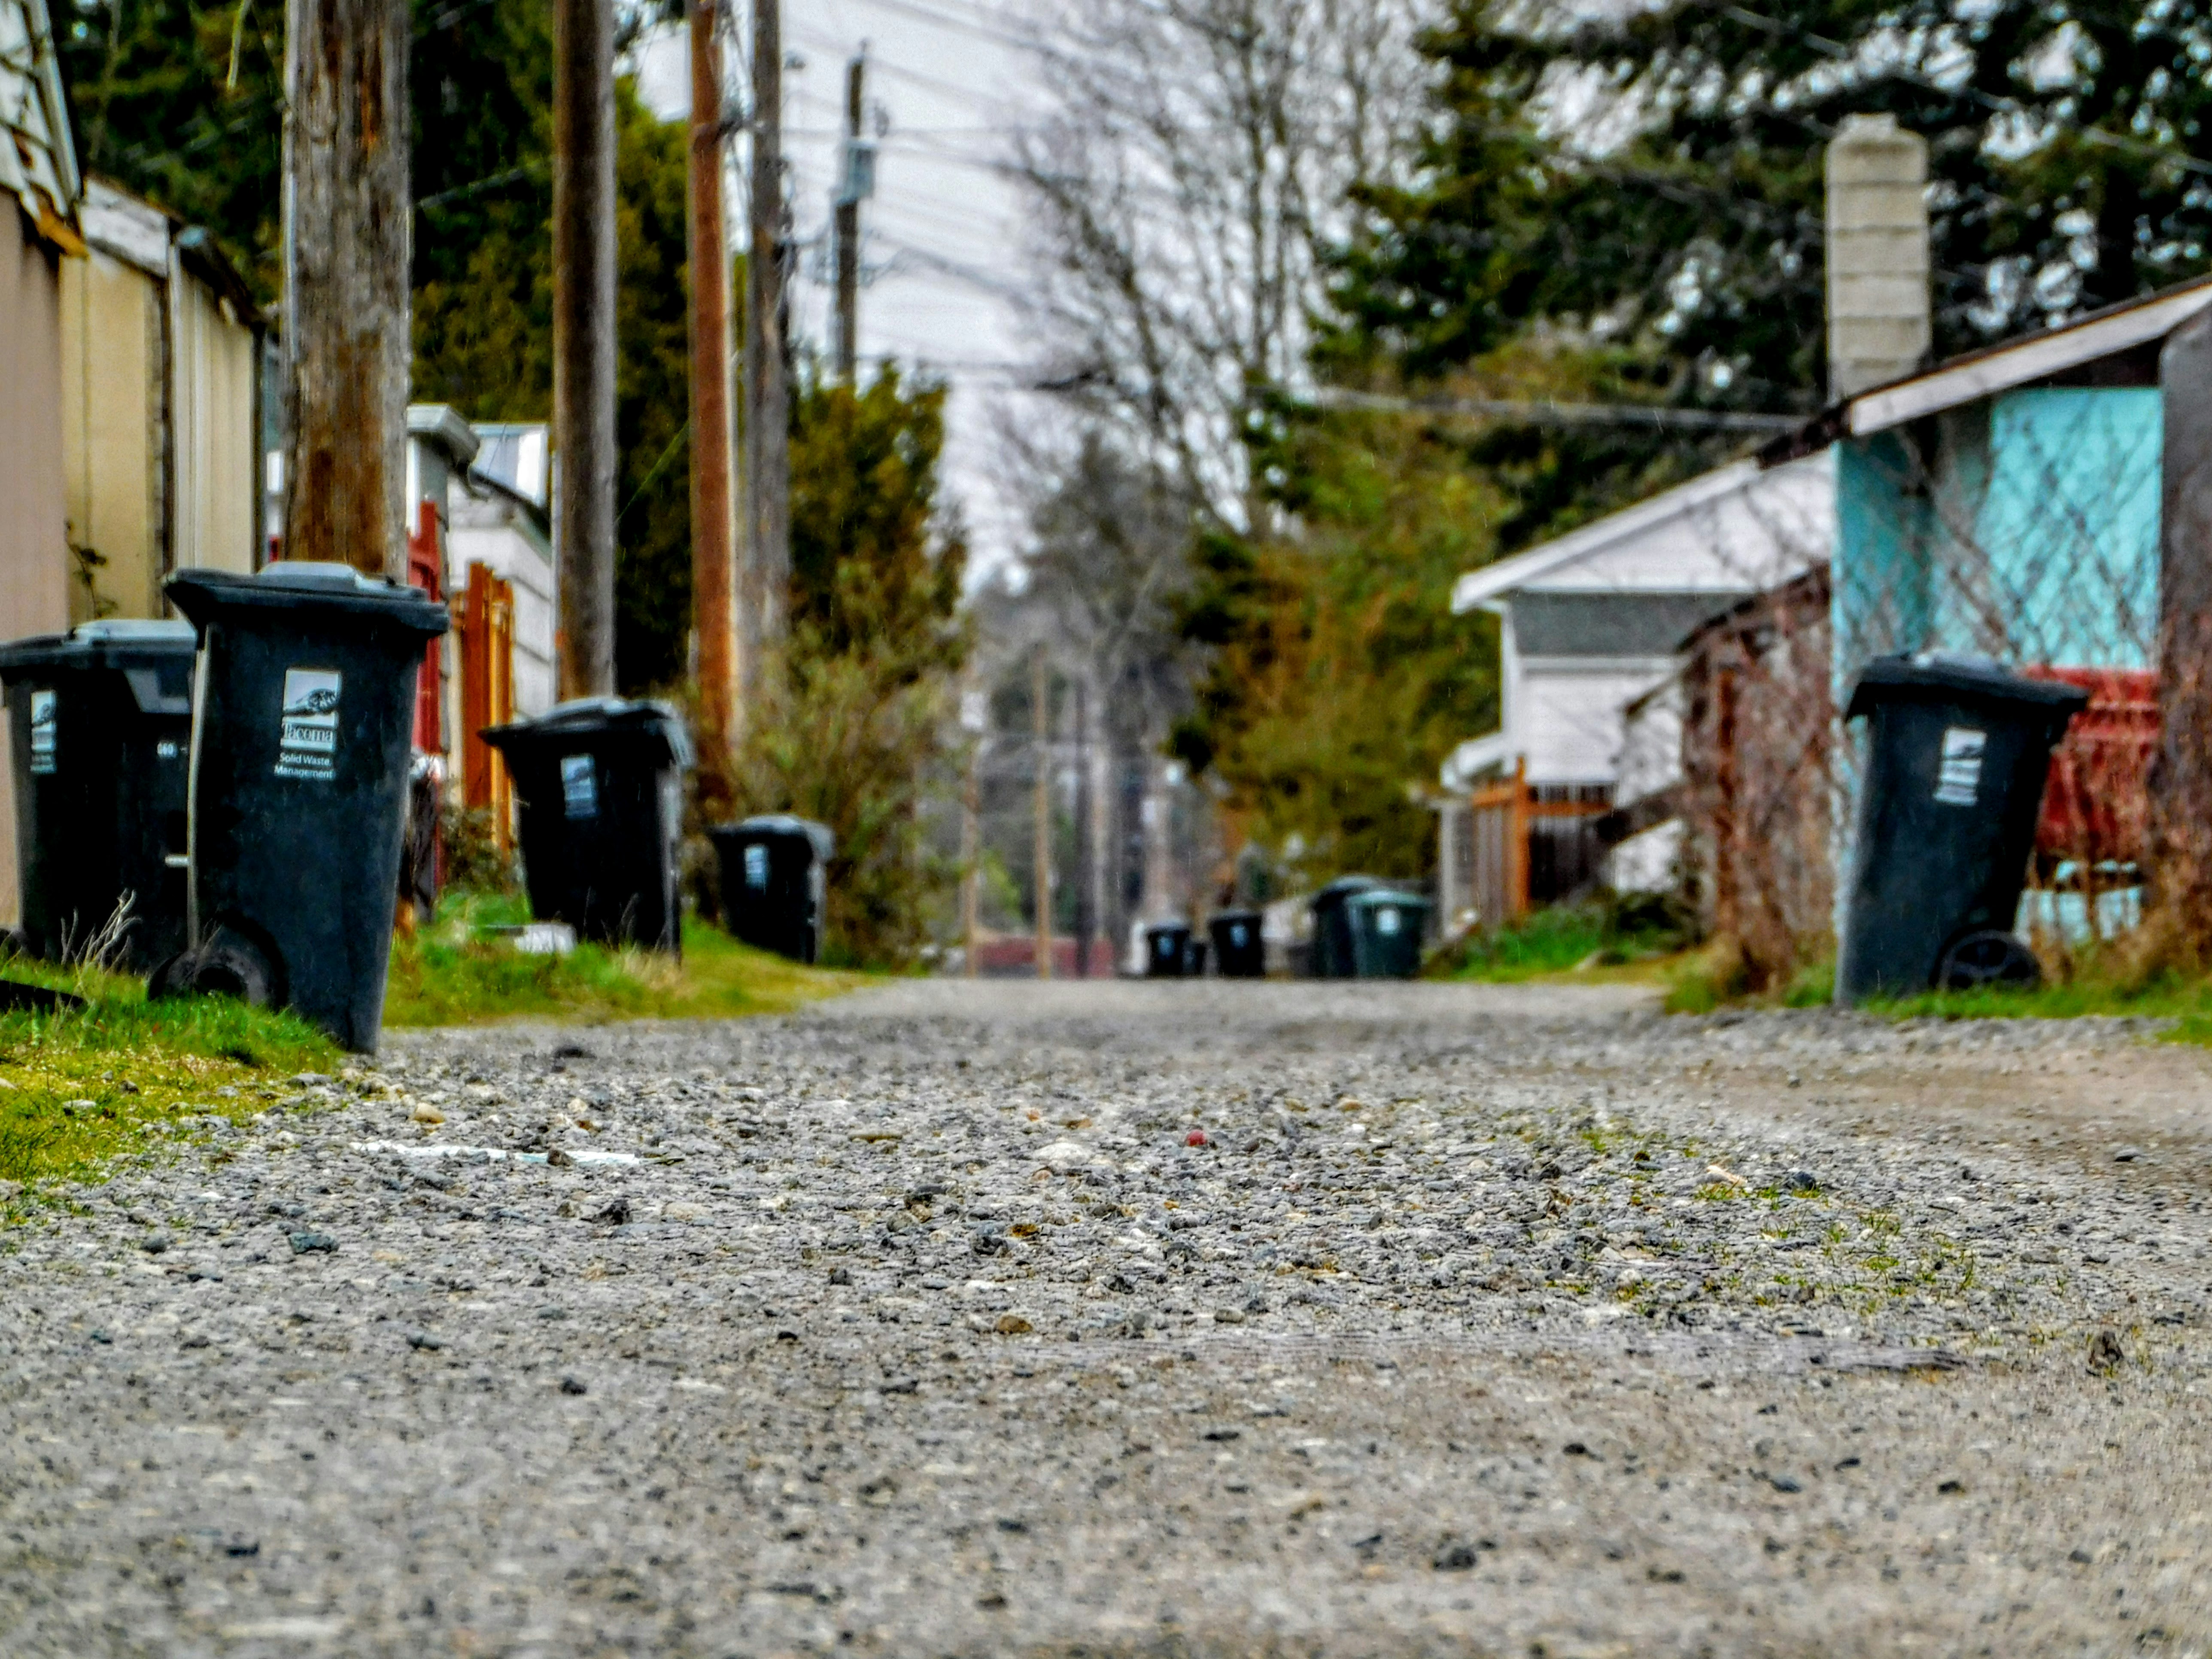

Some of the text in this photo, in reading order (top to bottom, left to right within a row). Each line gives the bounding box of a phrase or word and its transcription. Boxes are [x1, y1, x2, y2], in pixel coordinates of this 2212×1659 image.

[282, 723, 334, 742] Tacoma
[280, 752, 330, 766] Solid Waste
[274, 765, 334, 779] Management
